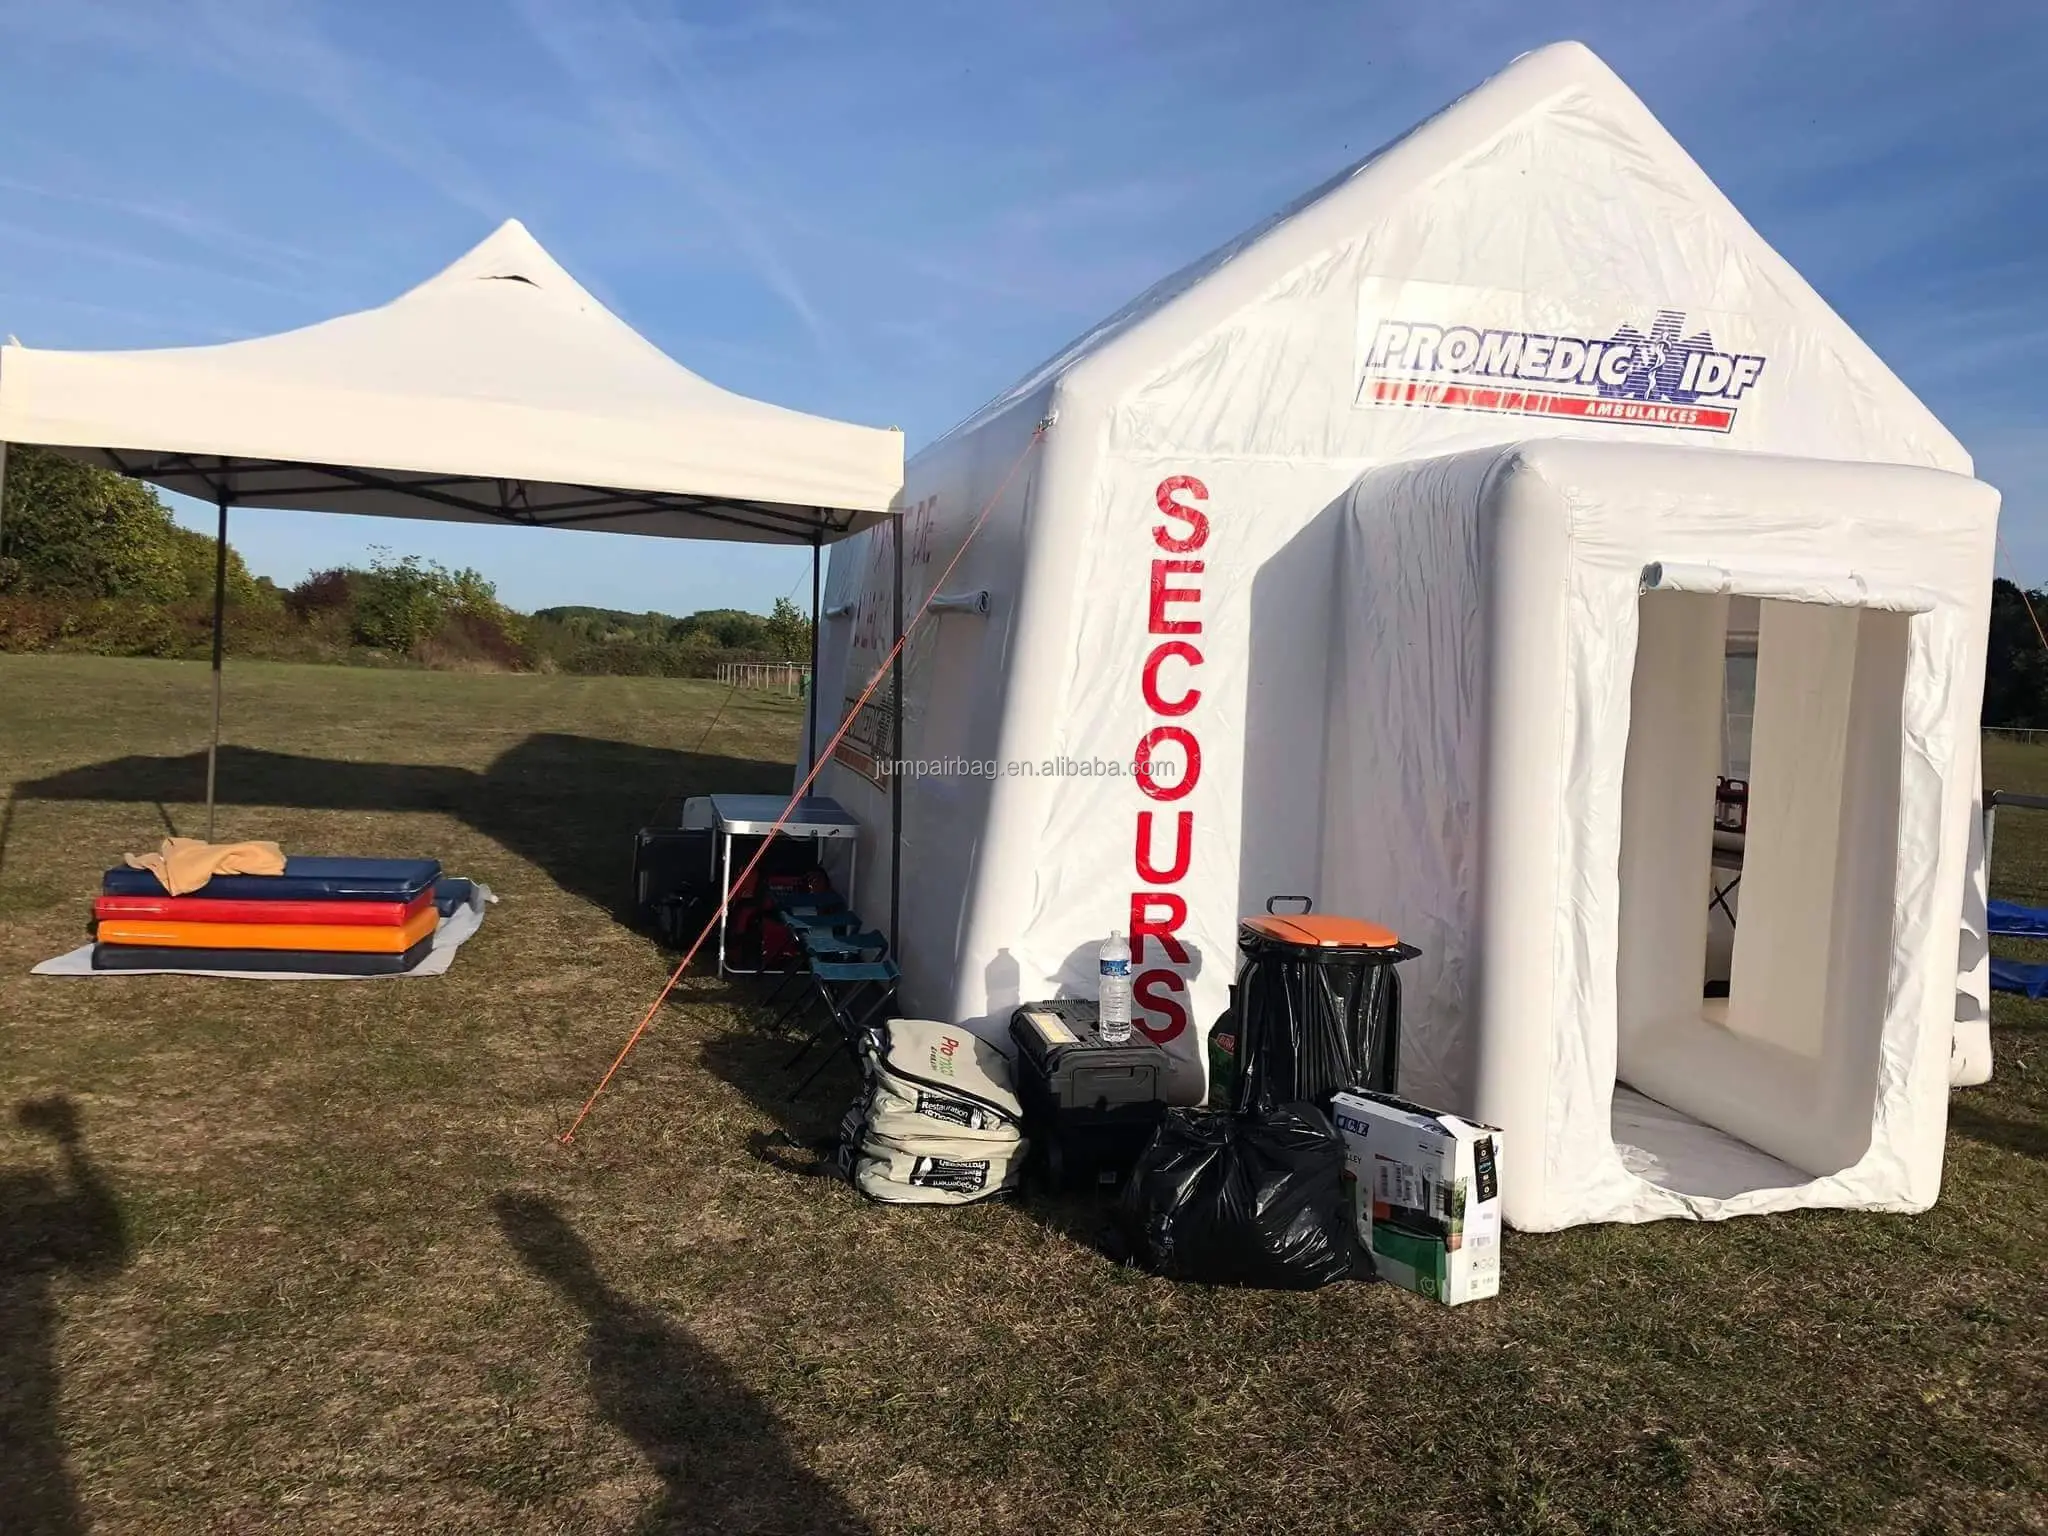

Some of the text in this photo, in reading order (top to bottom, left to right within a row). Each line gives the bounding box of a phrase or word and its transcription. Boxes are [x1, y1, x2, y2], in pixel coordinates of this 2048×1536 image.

[1366, 321, 1766, 400] PROMEDIC IDF
[1584, 402, 1699, 424] AMBULANCES
[1130, 475, 1210, 1045] SECOURS
[921, 1101, 969, 1118] Restauration
